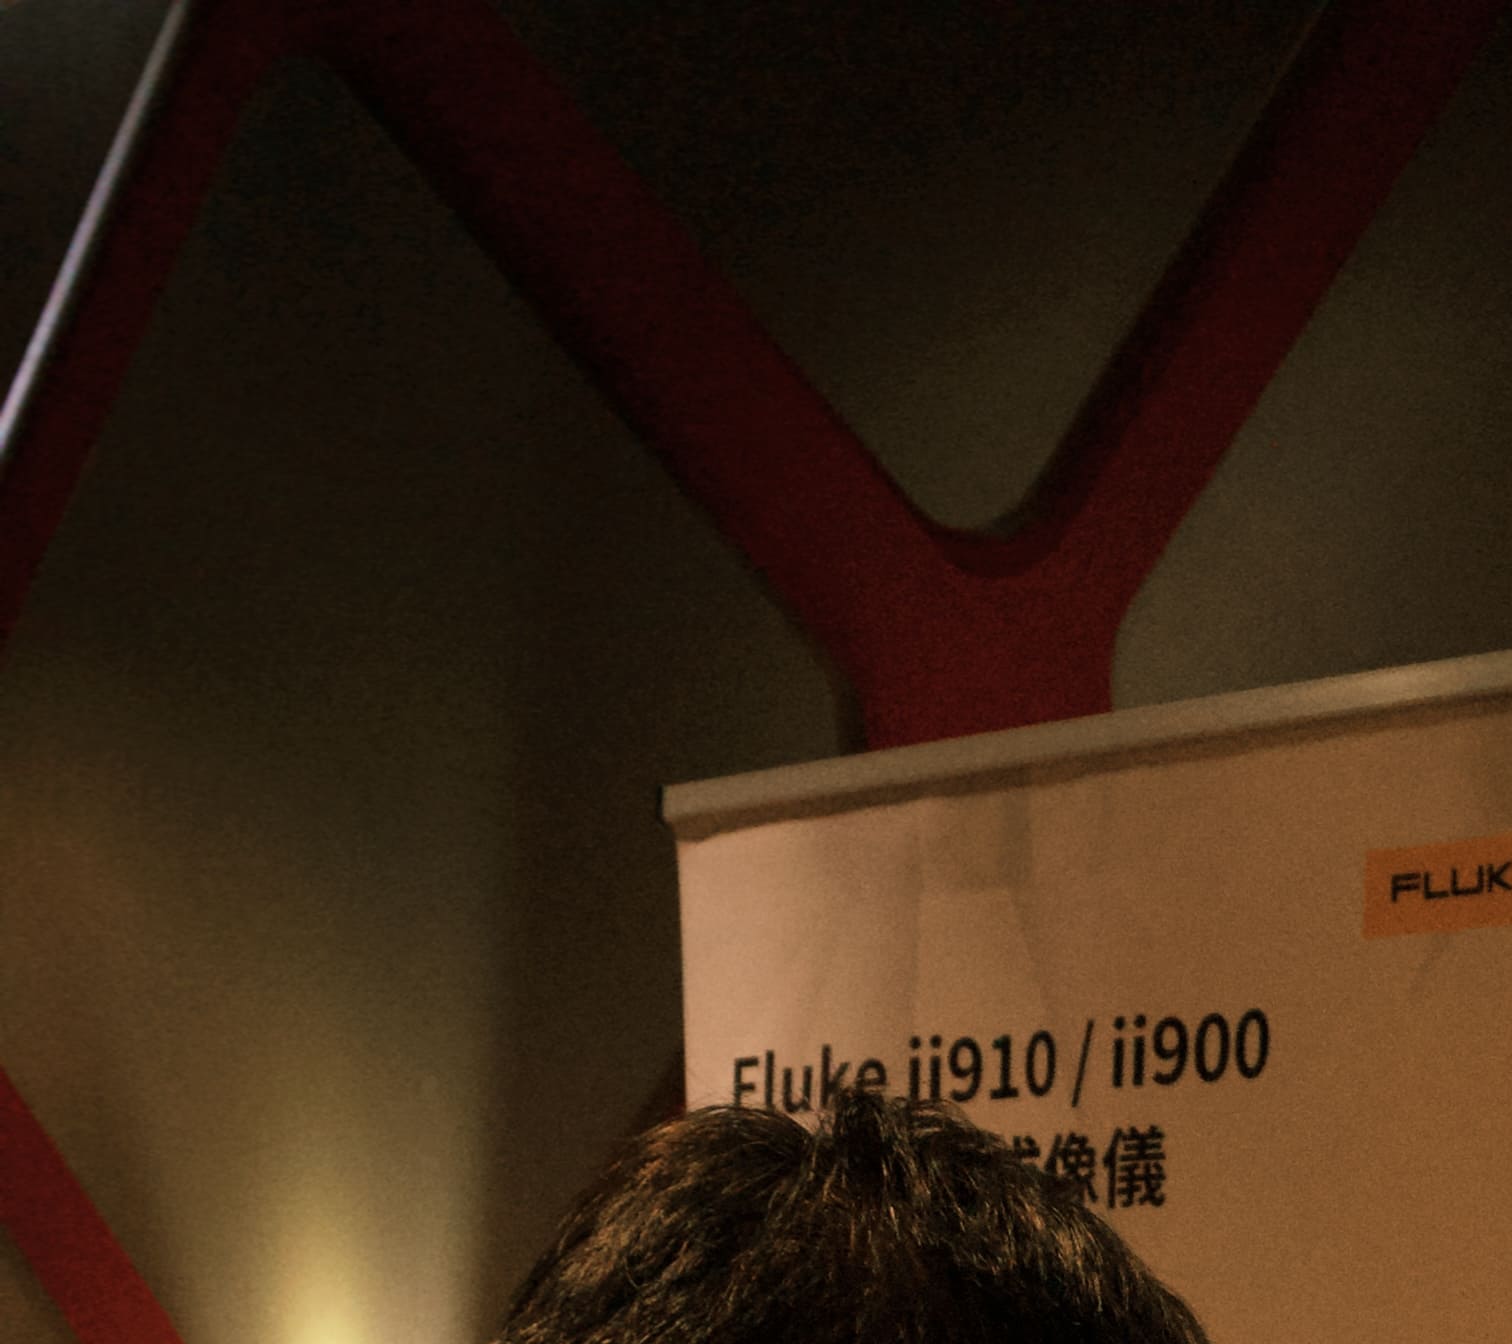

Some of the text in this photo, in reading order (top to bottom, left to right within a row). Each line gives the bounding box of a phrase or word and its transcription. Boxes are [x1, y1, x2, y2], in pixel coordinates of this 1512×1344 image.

[733, 1044, 888, 1114] Fluke
[908, 1029, 1057, 1102] ii910
[1111, 1008, 1271, 1089] ii900
